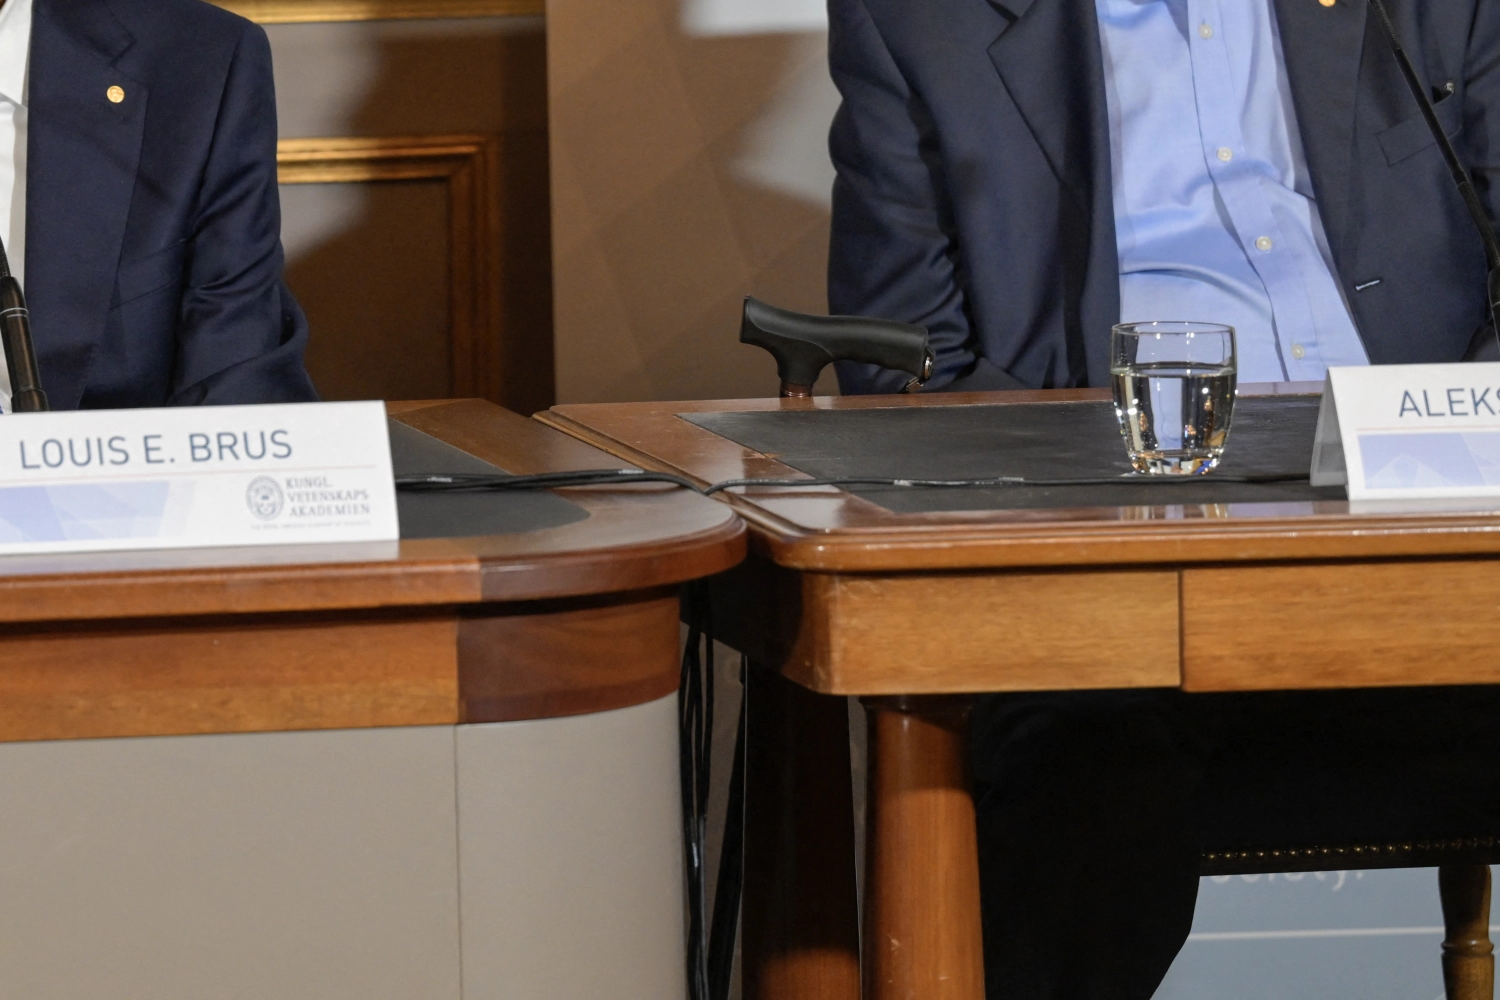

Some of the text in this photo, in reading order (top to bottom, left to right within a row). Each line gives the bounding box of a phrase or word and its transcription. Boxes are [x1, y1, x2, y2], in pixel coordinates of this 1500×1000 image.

[1398, 387, 1500, 418] ALEK
[19, 429, 293, 470] LOUIS E. BRUS
